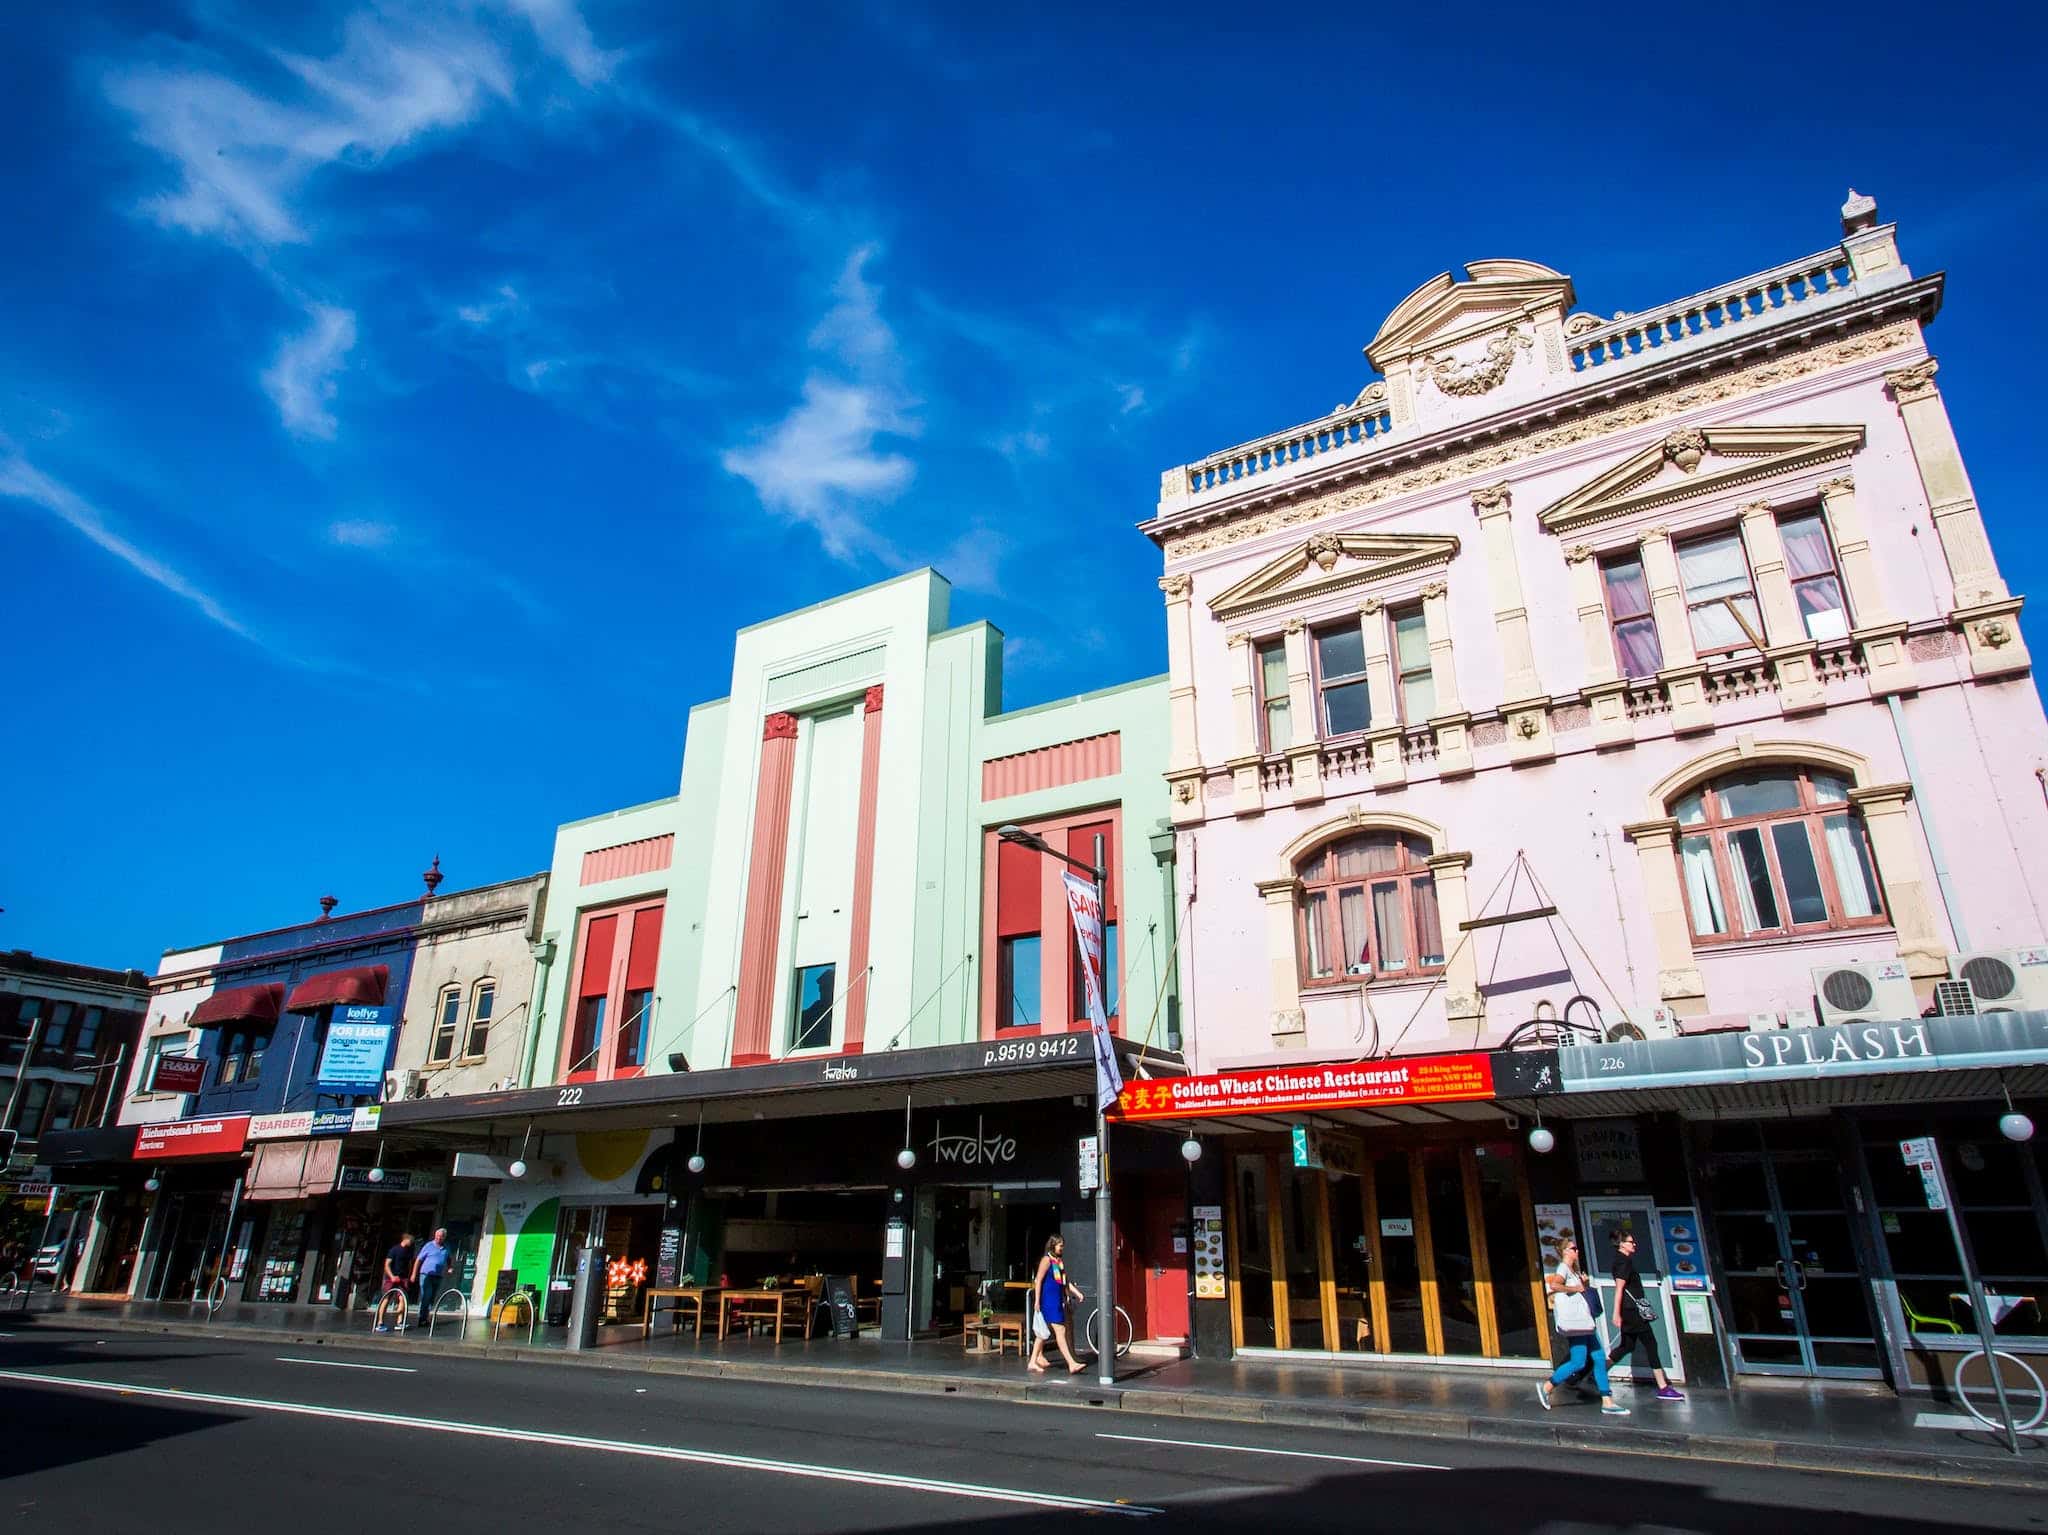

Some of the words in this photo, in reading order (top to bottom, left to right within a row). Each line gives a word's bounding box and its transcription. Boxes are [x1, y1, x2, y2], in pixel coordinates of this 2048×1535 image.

[347, 1007, 379, 1019] kellys
[330, 1026, 353, 1036] FOR
[355, 1025, 388, 1037] LEASE
[1039, 1038, 1078, 1057] 9412
[1743, 1025, 1933, 1067] SPLASH
[822, 1060, 858, 1080] twelve
[1600, 1057, 1625, 1070] 226
[1172, 1082, 1219, 1098] Golden
[1219, 1078, 1263, 1096] Wheat
[1265, 1074, 1321, 1092] Chinese
[1323, 1066, 1409, 1088] Restaurant
[557, 1087, 583, 1106] 222
[259, 1118, 306, 1131] BARBER
[927, 1114, 1017, 1165] twelve
[22, 1183, 66, 1194] CHICN
